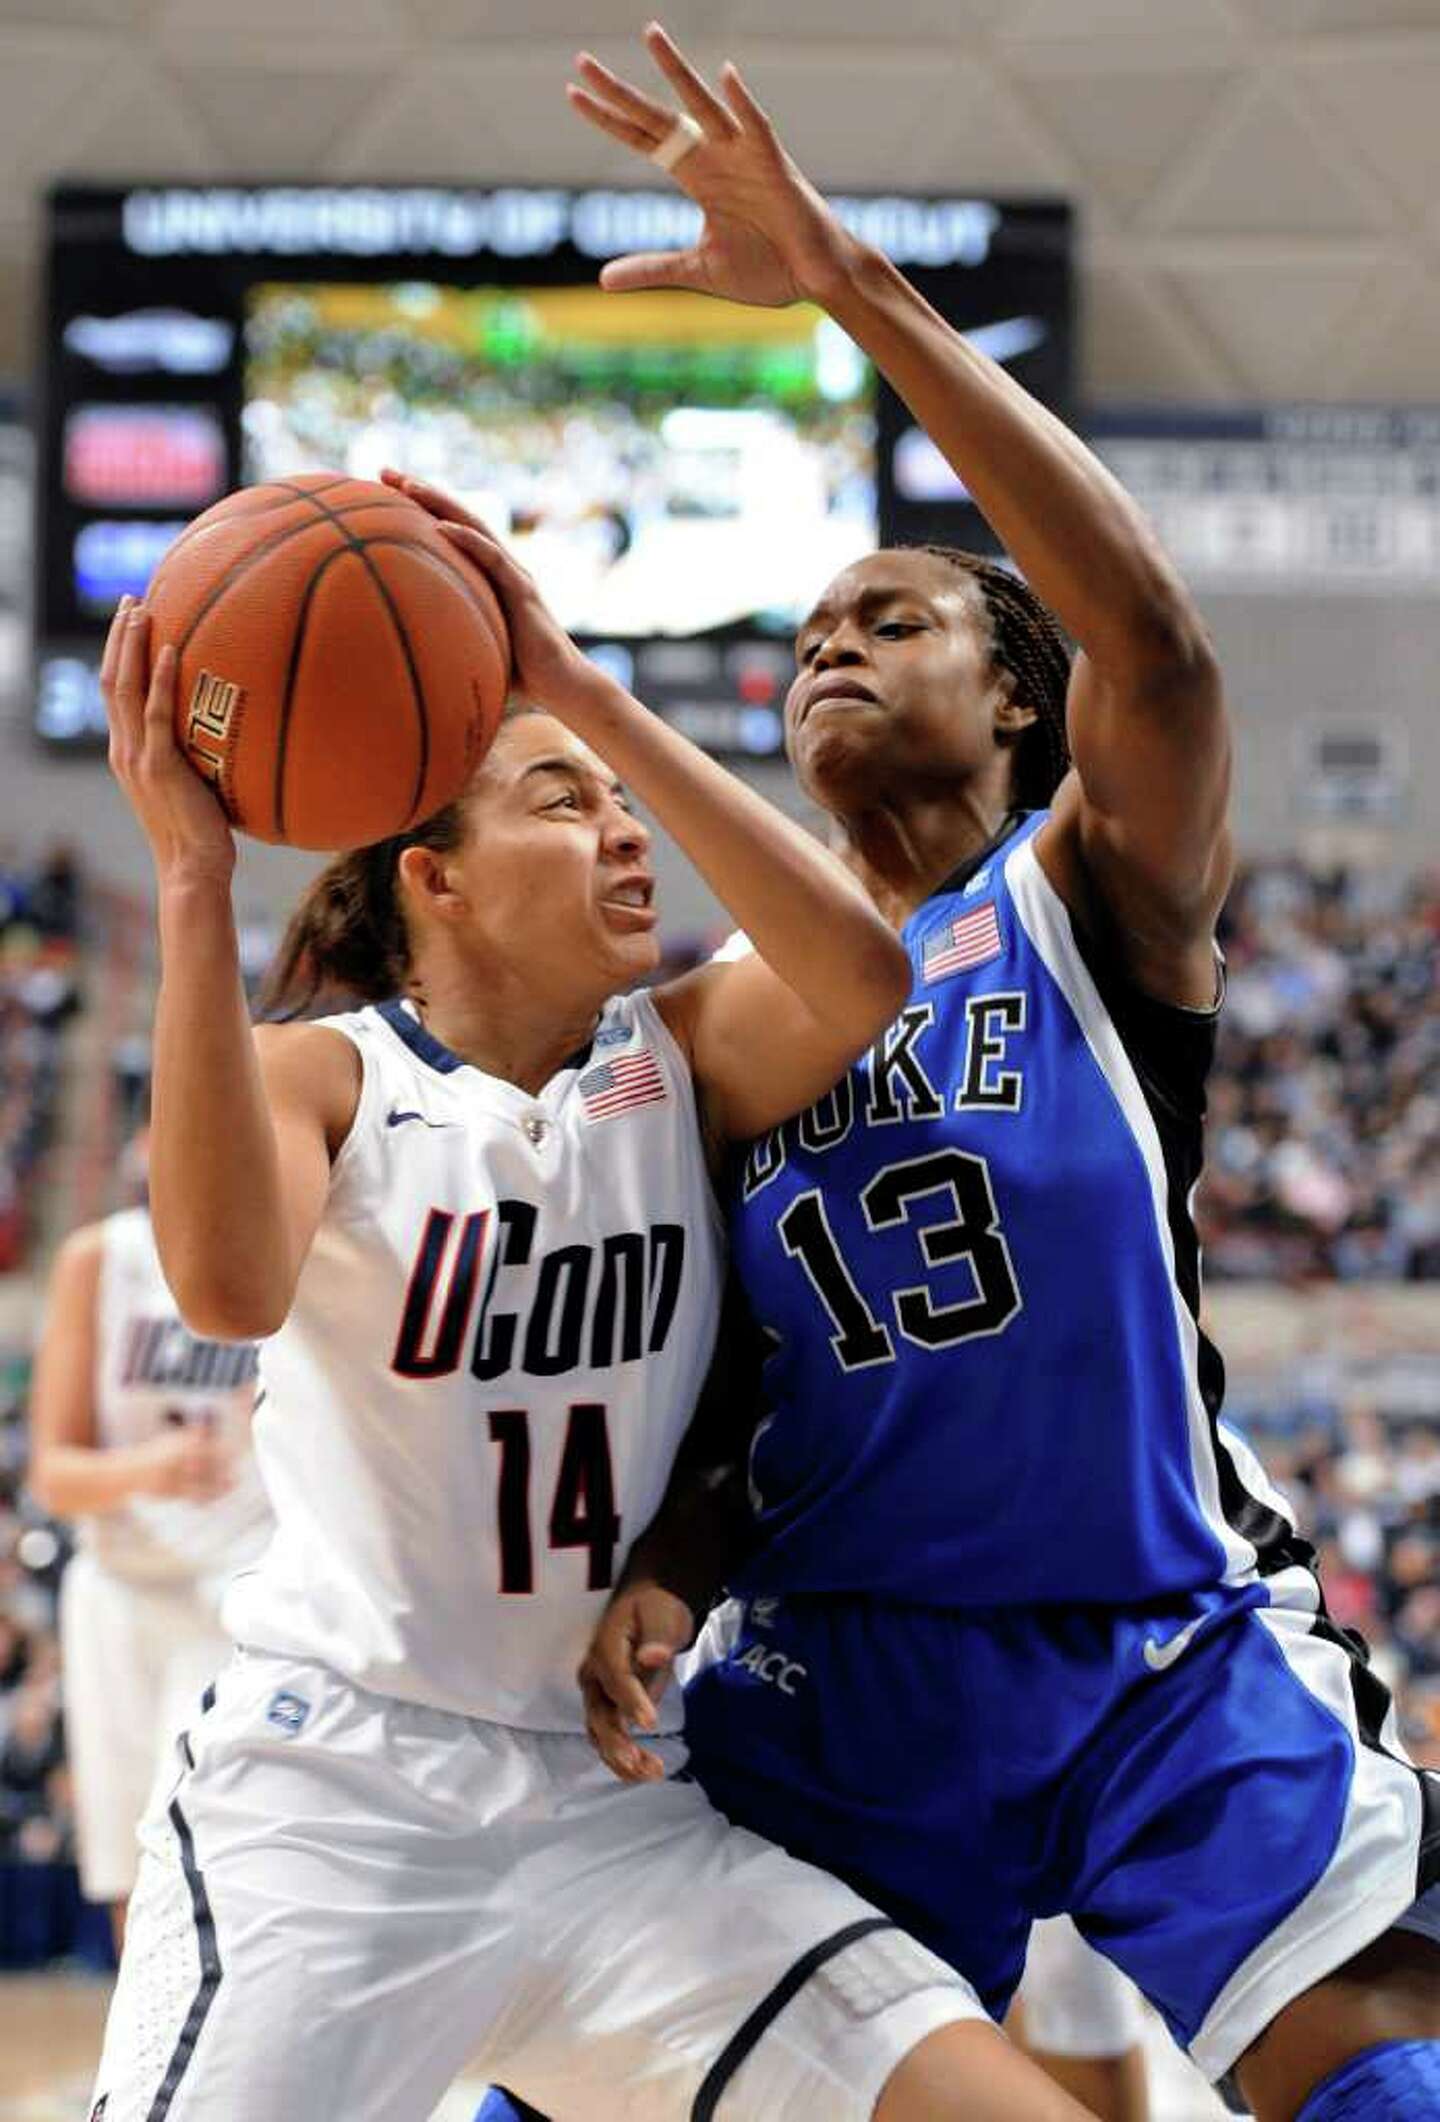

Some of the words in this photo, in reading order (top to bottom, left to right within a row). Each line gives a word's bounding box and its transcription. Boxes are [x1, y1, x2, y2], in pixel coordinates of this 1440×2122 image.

[743, 991, 1027, 1202] DUKE
[391, 1199, 686, 1381] UConn
[776, 1146, 1023, 1373] 13
[487, 1403, 622, 1596] 14
[732, 1643, 808, 1696] ACC
